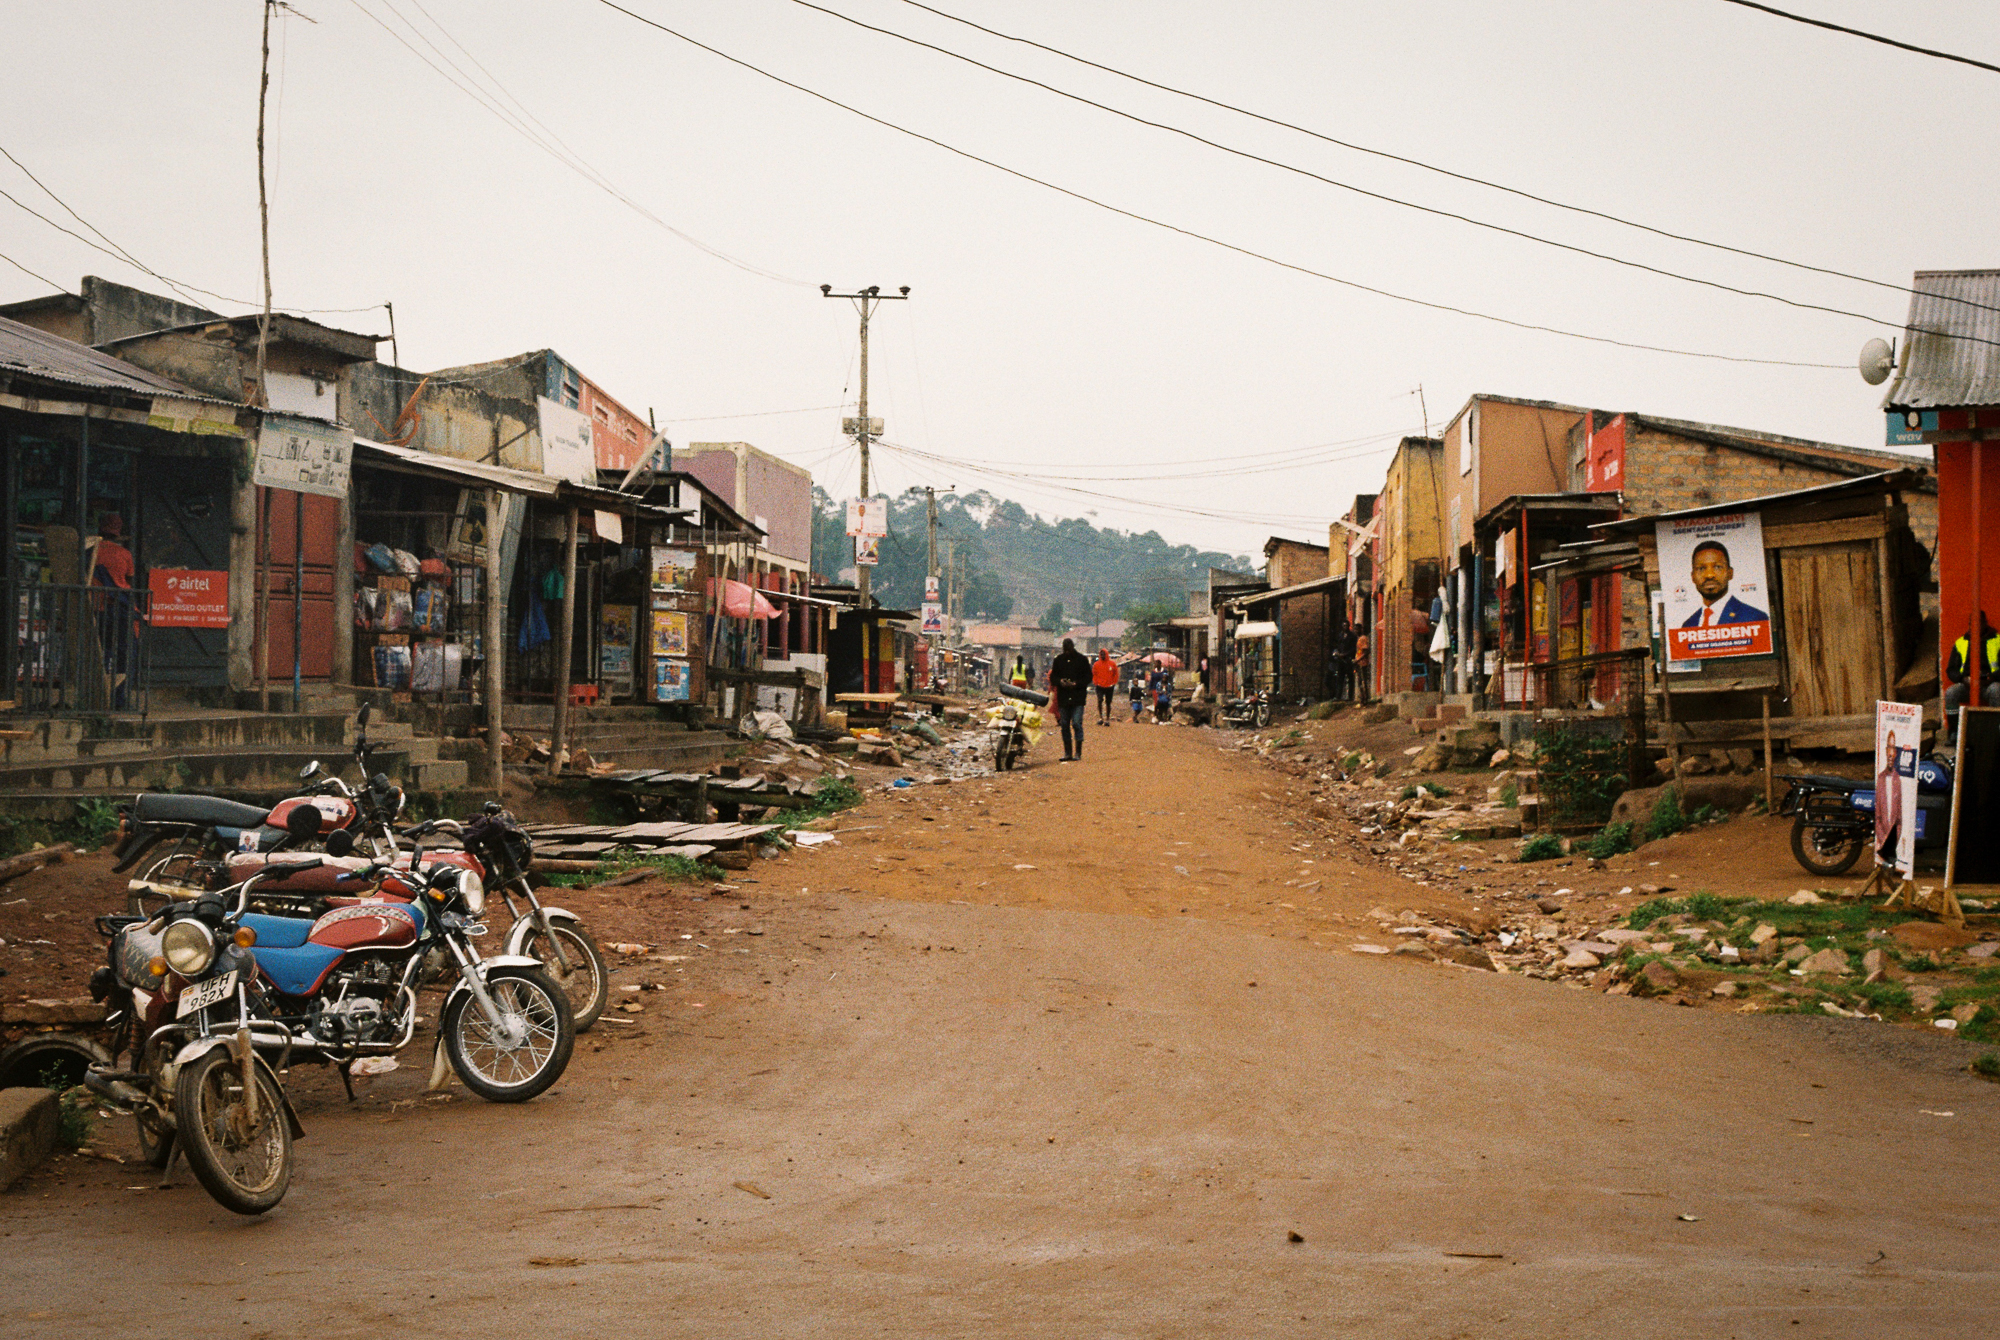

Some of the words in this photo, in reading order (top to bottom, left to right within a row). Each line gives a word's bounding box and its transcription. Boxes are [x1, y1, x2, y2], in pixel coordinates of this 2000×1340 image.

[179, 576, 210, 590] airtel
[196, 604, 225, 612] OUTLET
[1678, 625, 1760, 643] PRESIDENT
[201, 972, 230, 993] UFH
